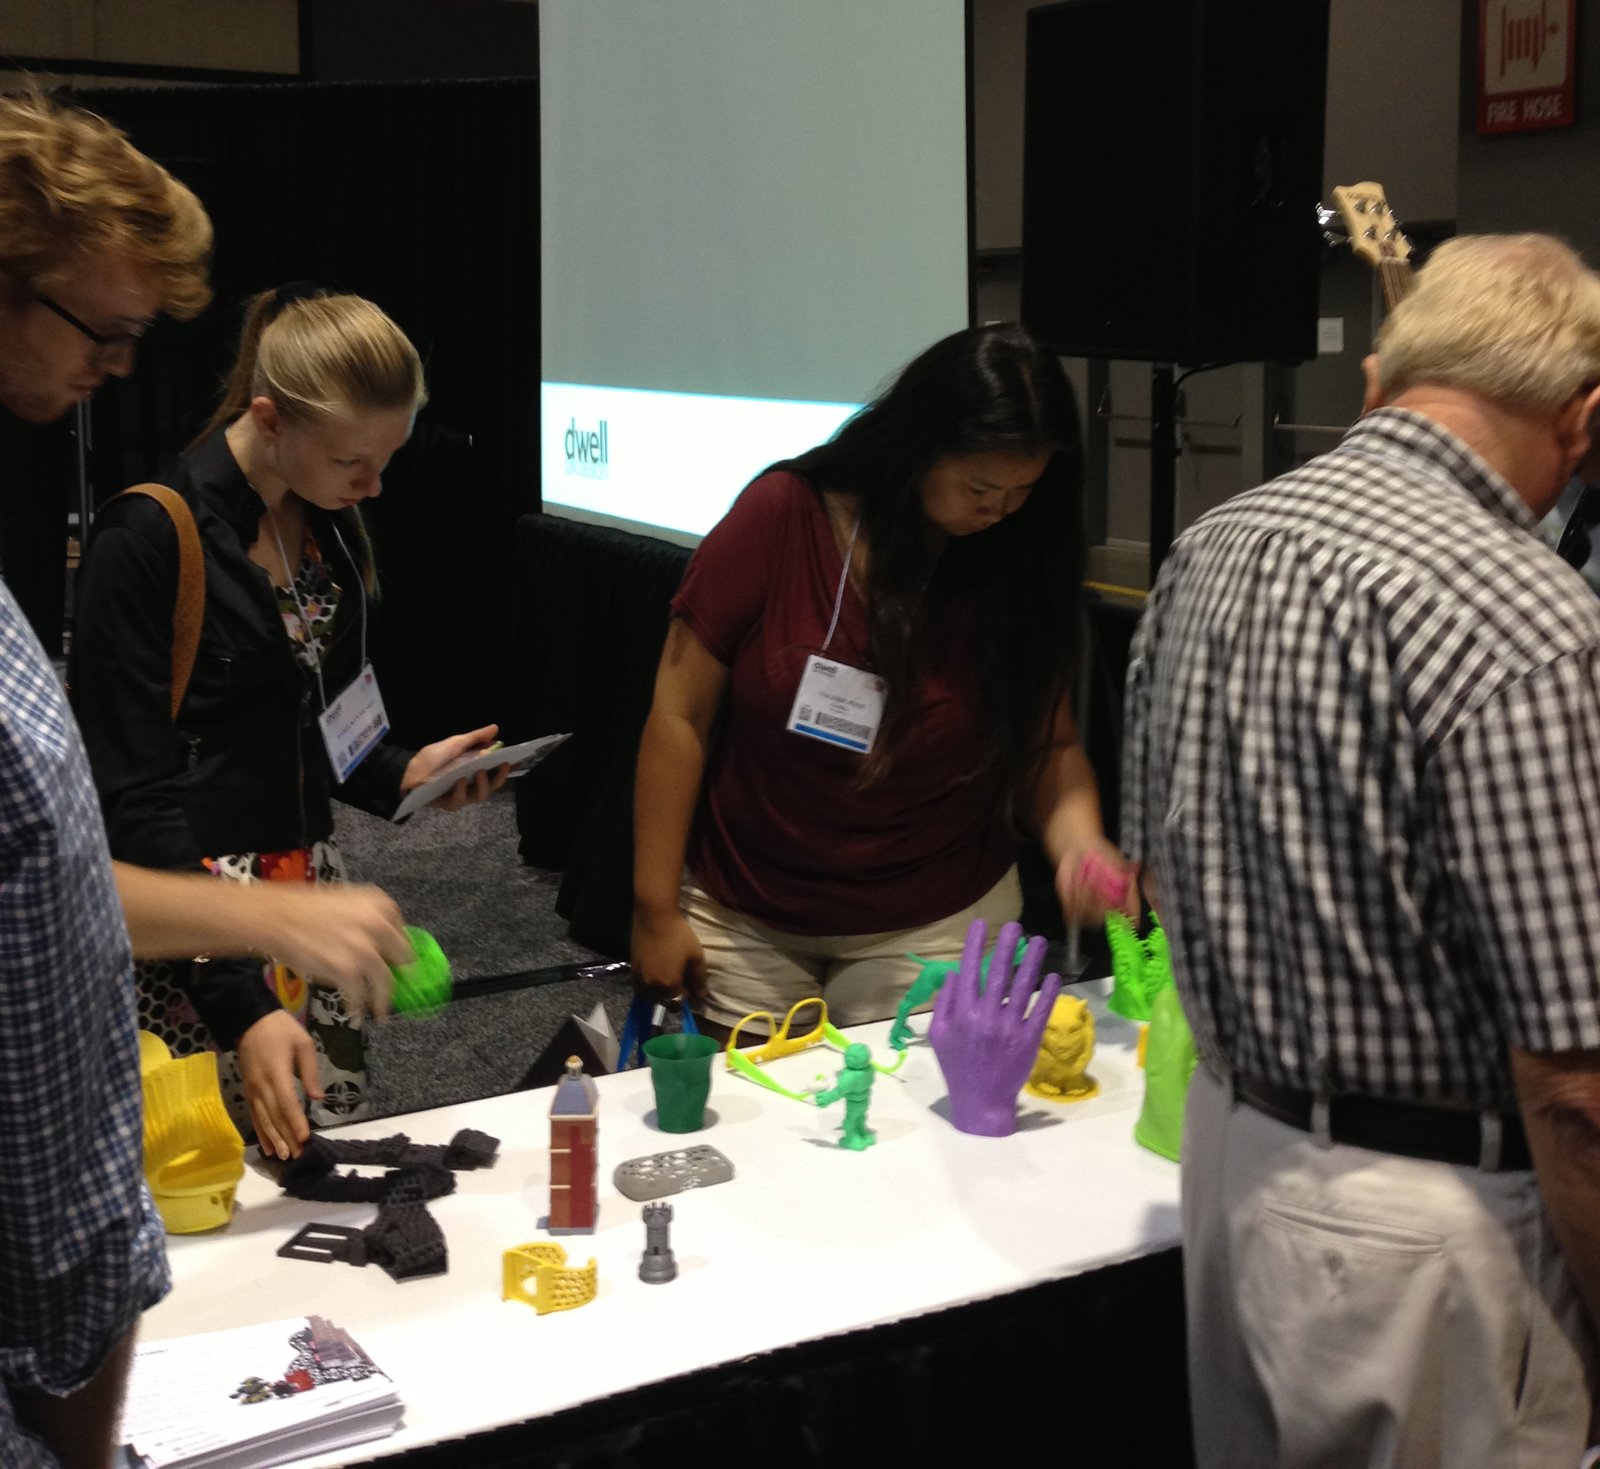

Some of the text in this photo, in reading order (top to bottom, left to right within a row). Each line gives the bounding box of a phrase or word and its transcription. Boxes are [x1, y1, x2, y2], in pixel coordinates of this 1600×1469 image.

[1486, 94, 1563, 126] FIRE HOSE
[565, 417, 608, 464] dwell
